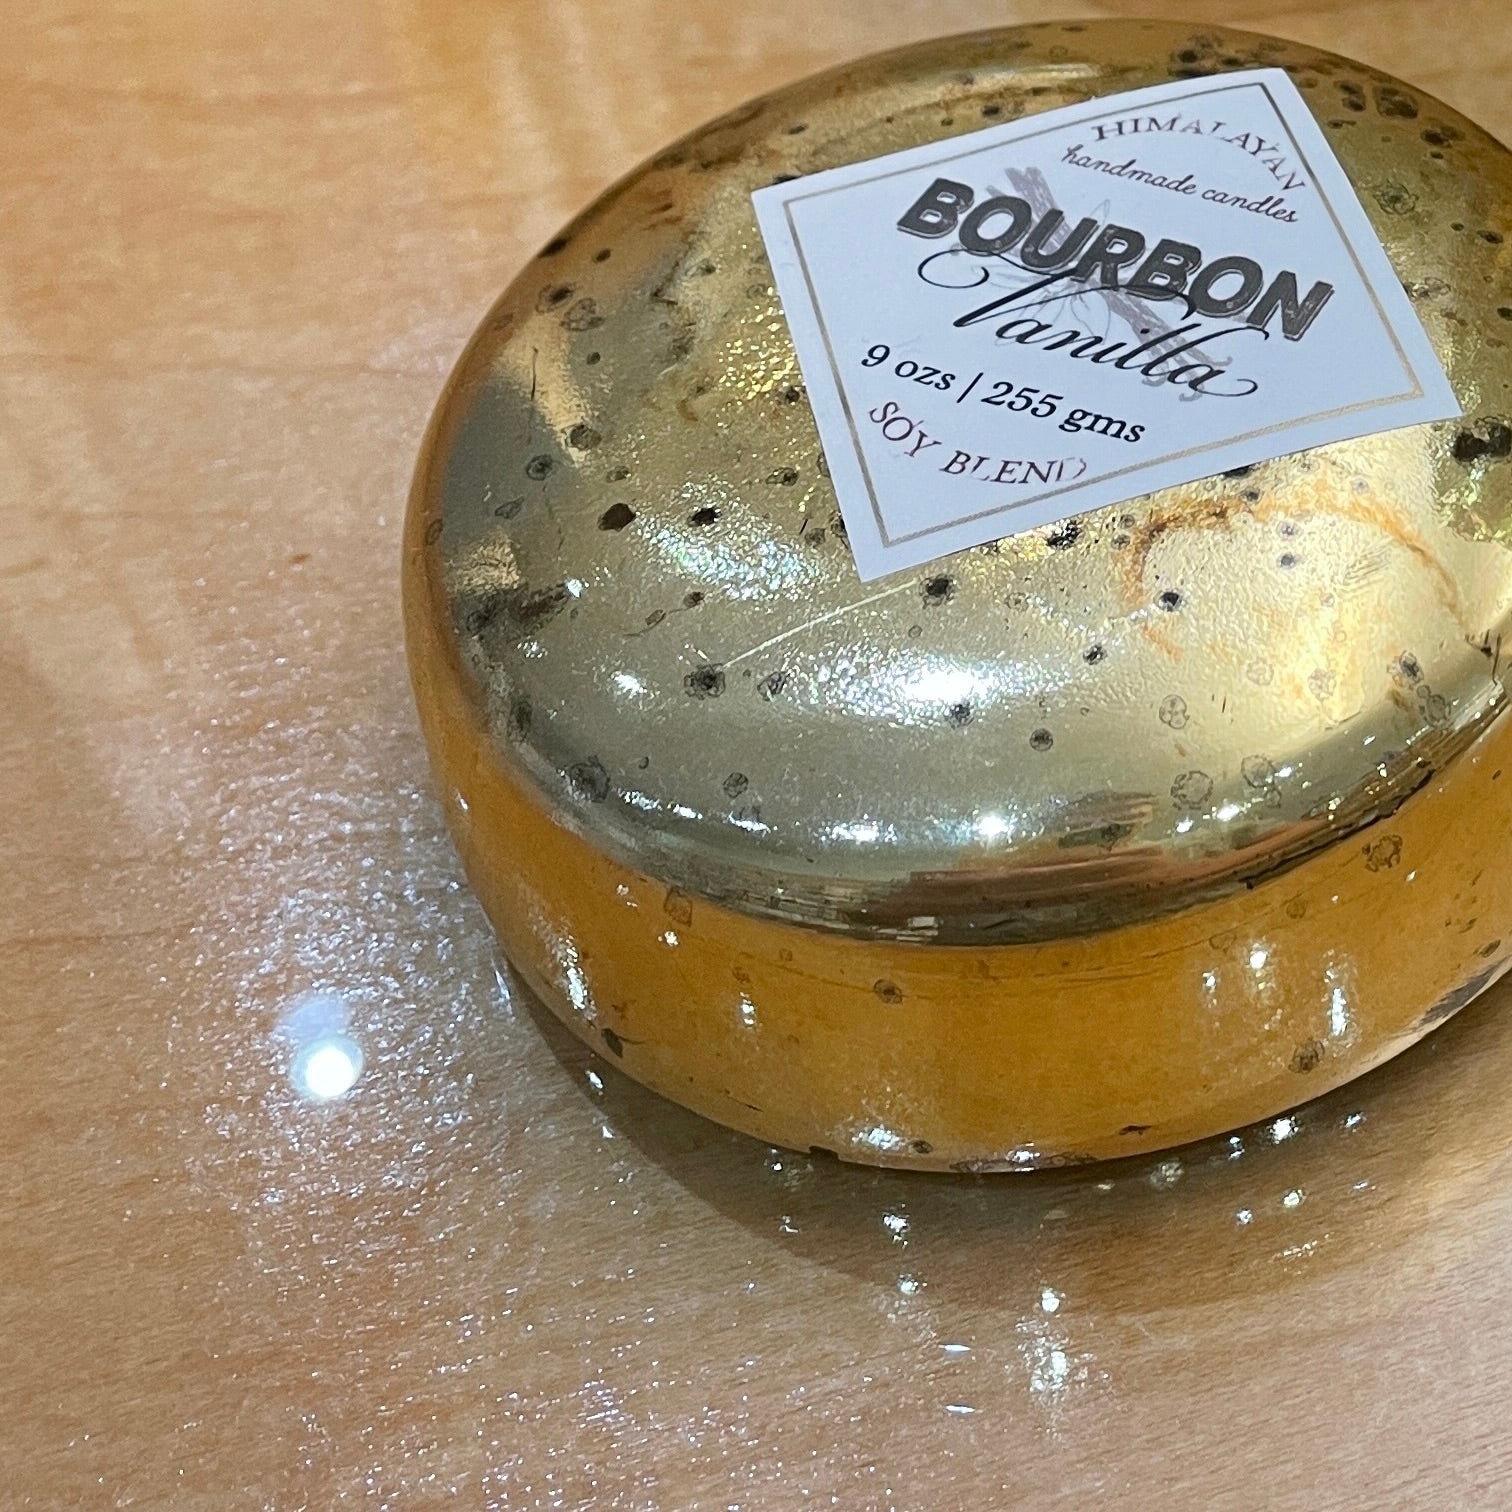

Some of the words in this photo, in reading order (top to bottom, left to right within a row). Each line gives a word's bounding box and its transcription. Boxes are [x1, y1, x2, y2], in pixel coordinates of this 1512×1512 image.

[1061, 143, 1197, 196] handmade
[1201, 186, 1299, 224] candles
[1091, 113, 1306, 192] HIMALAYAN
[896, 177, 1335, 342] BOURBON
[917, 248, 1270, 398] Vanilla
[860, 344, 891, 368] 9
[894, 359, 957, 391] ozs
[981, 380, 1064, 419] 255
[1058, 407, 1147, 443] gms
[868, 400, 942, 459] SOY
[939, 449, 1088, 486] BLEND
